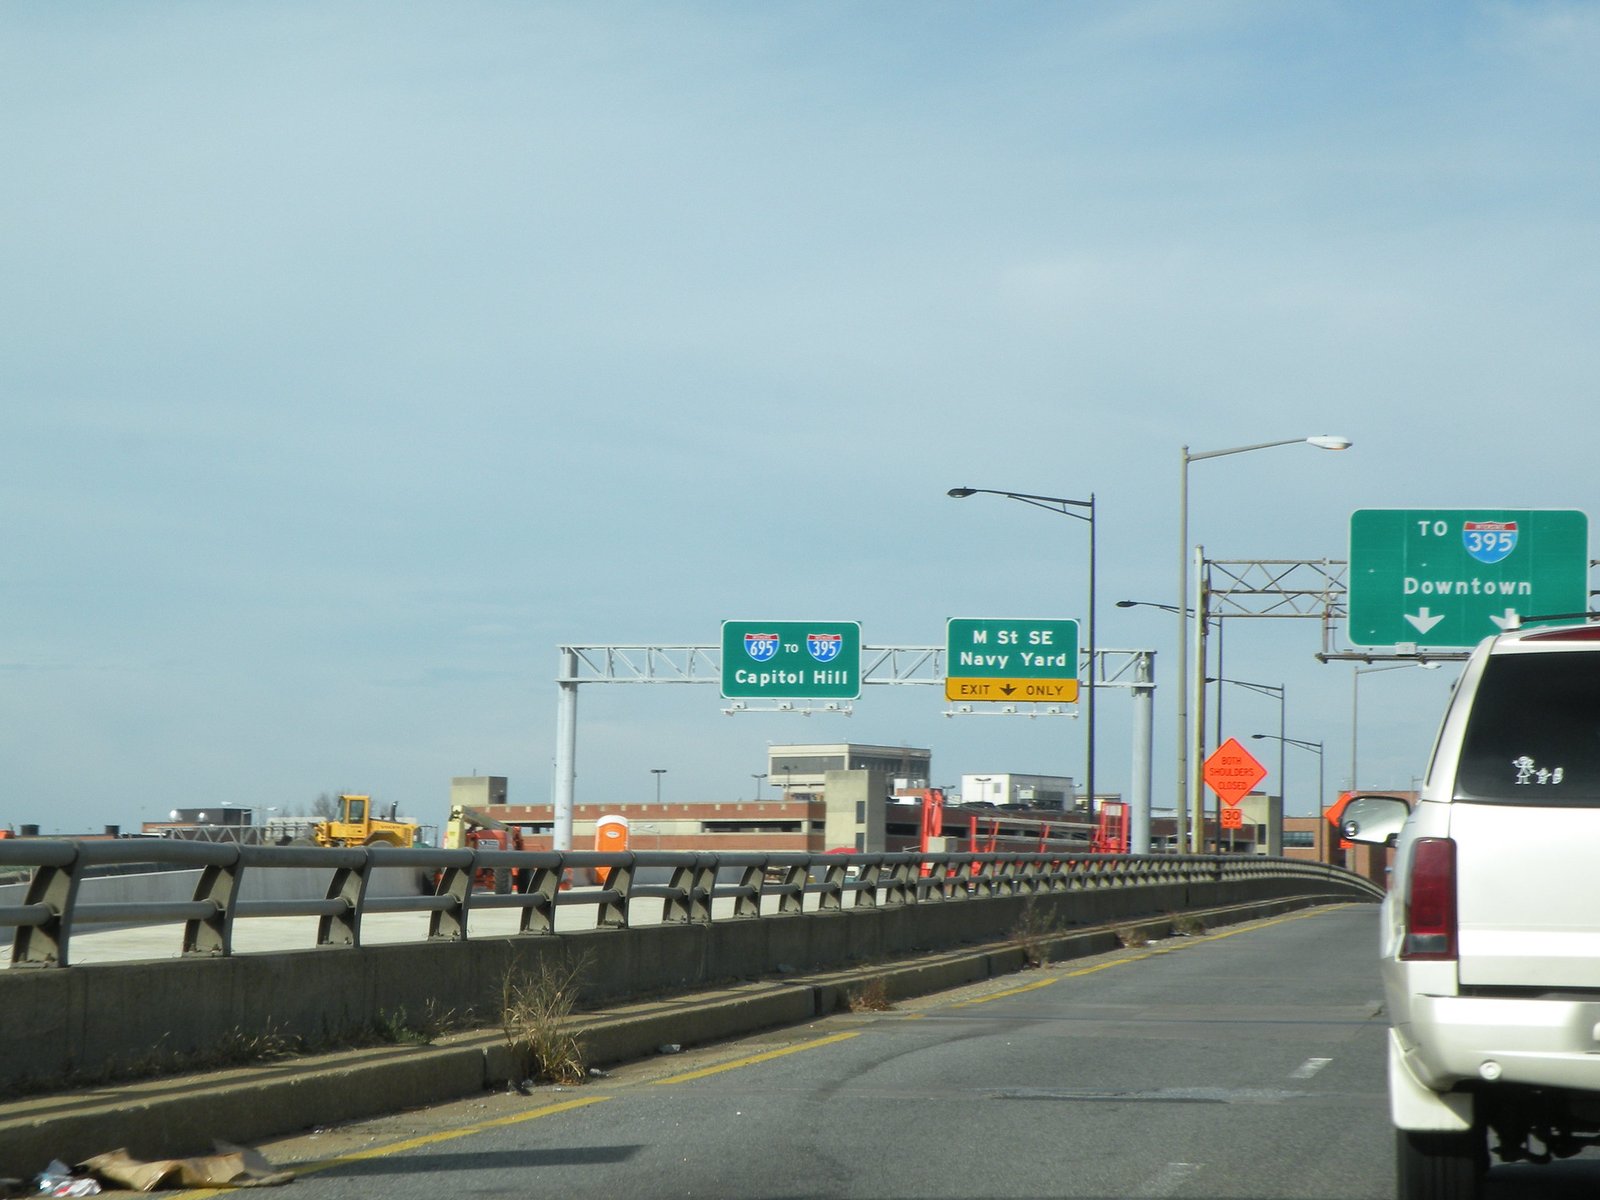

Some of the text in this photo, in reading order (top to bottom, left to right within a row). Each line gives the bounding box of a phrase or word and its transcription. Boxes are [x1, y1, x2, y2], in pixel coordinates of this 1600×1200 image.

[1417, 520, 1513, 552] TO 395
[1404, 577, 1531, 595] Downtown
[973, 630, 1053, 645] M St SE
[750, 641, 836, 656] 695 TO 395
[960, 651, 1066, 669] Navy Yard
[735, 670, 847, 686] Capitol Hill
[961, 684, 1063, 695] EXIT ONLY
[1221, 757, 1242, 765] BOTH
[1209, 768, 1255, 776] SHOULDERS
[1218, 782, 1247, 790] CLOSED
[1224, 811, 1240, 820] 30
